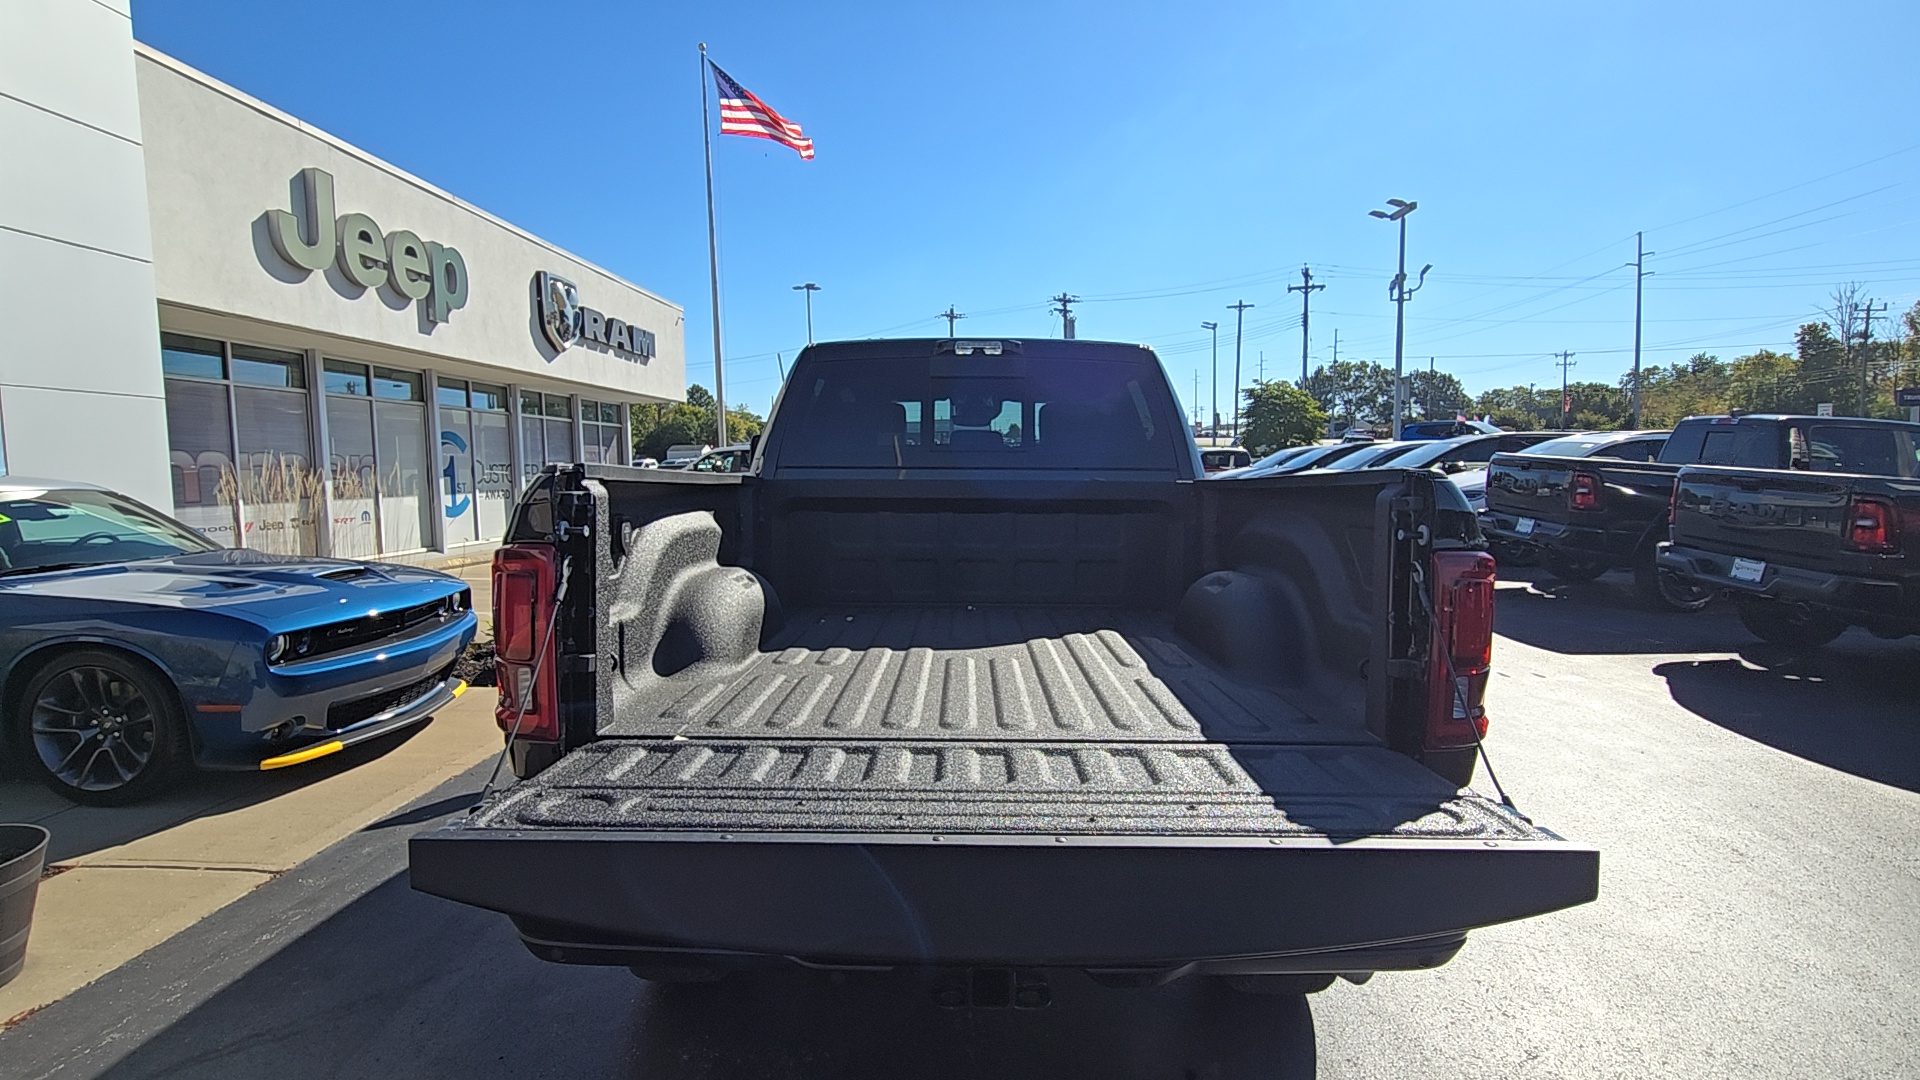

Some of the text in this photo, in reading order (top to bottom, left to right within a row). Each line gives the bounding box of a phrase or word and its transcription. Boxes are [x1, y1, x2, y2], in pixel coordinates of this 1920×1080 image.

[265, 168, 468, 323] Jeep
[580, 306, 656, 359] RAM
[258, 519, 285, 532] Jeep
